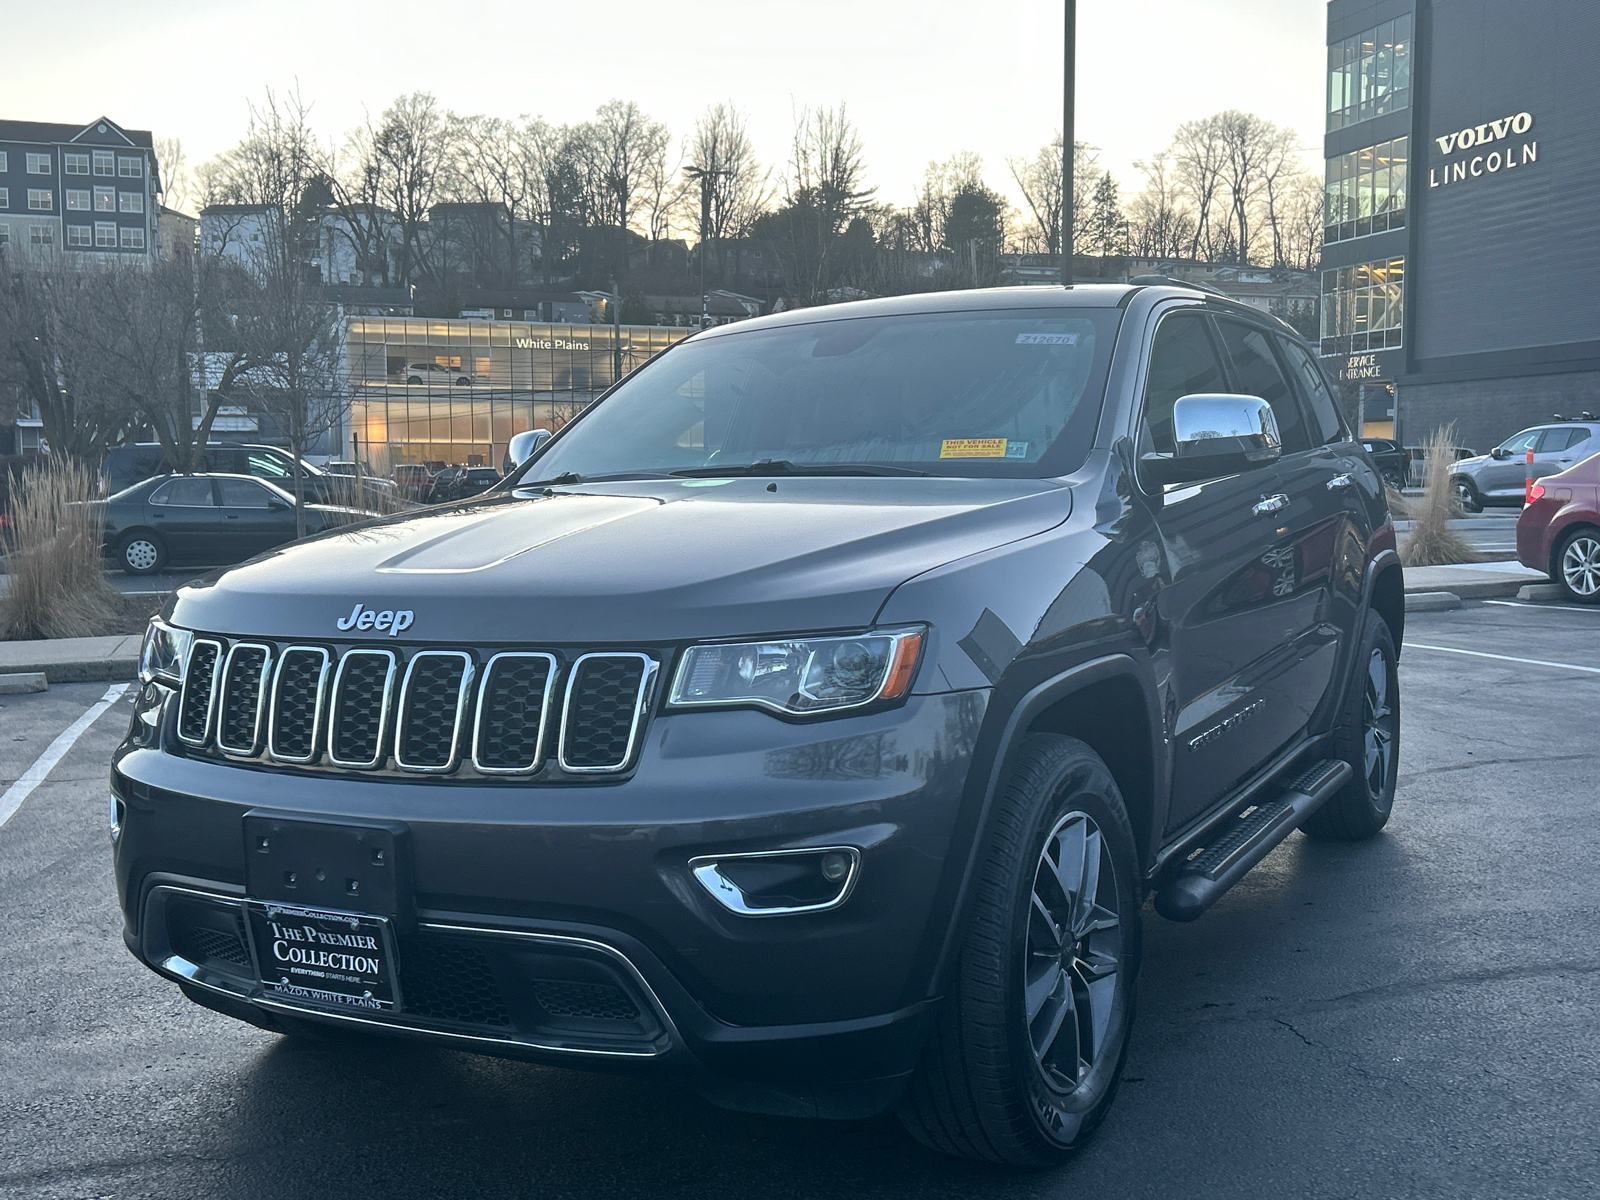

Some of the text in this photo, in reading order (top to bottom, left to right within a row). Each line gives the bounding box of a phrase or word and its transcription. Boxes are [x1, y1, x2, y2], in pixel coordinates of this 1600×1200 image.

[1436, 112, 1532, 155] VOLVO
[1430, 142, 1537, 188] LINCOLN
[516, 338, 589, 350] White Plains
[1020, 335, 1070, 344] Z12670
[337, 603, 414, 637] Jeep
[290, 967, 325, 978] EVERYTHING
[325, 972, 345, 981] STARTS
[274, 985, 381, 1009] MAZDA WHITE PLAINS
